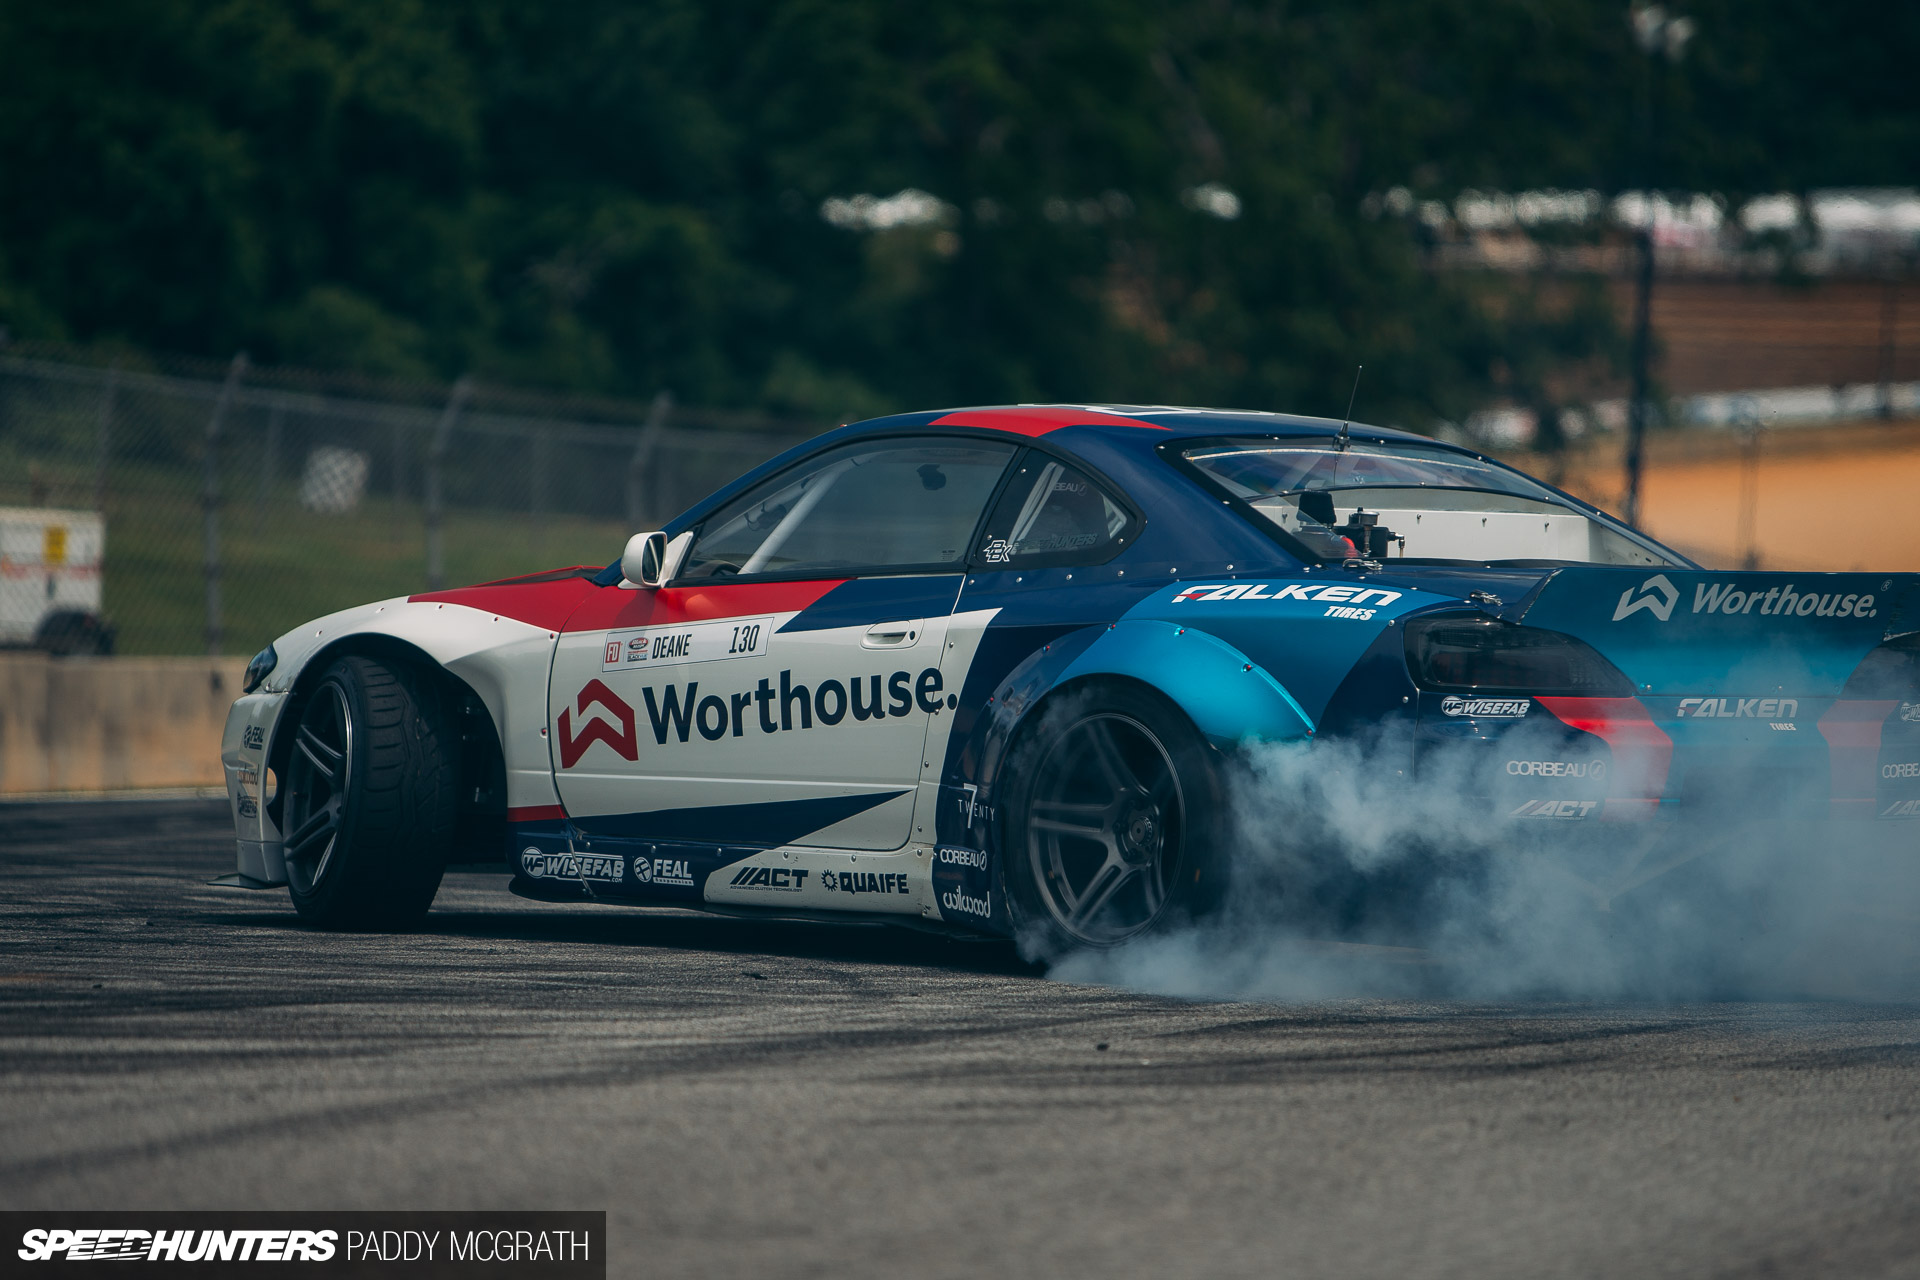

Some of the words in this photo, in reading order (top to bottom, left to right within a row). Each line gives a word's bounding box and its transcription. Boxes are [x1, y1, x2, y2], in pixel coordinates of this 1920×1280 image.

[1171, 584, 1402, 607] FALKEN
[1323, 605, 1377, 621] TIRES
[652, 634, 692, 659] DEANE
[728, 624, 761, 654] 130
[642, 667, 958, 745] Worthouse.
[1463, 701, 1531, 714] WISEFAB
[1676, 698, 1798, 718] FALKEN
[1769, 722, 1797, 731] TIRES
[1506, 760, 1587, 778] CORBEAU
[1882, 763, 1920, 779] CORBE
[546, 857, 624, 878] WISEFAB
[940, 848, 979, 868] CORBEAU
[653, 859, 692, 878] FEAL
[838, 872, 910, 894] QUAIFE
[943, 885, 991, 918] wilwood
